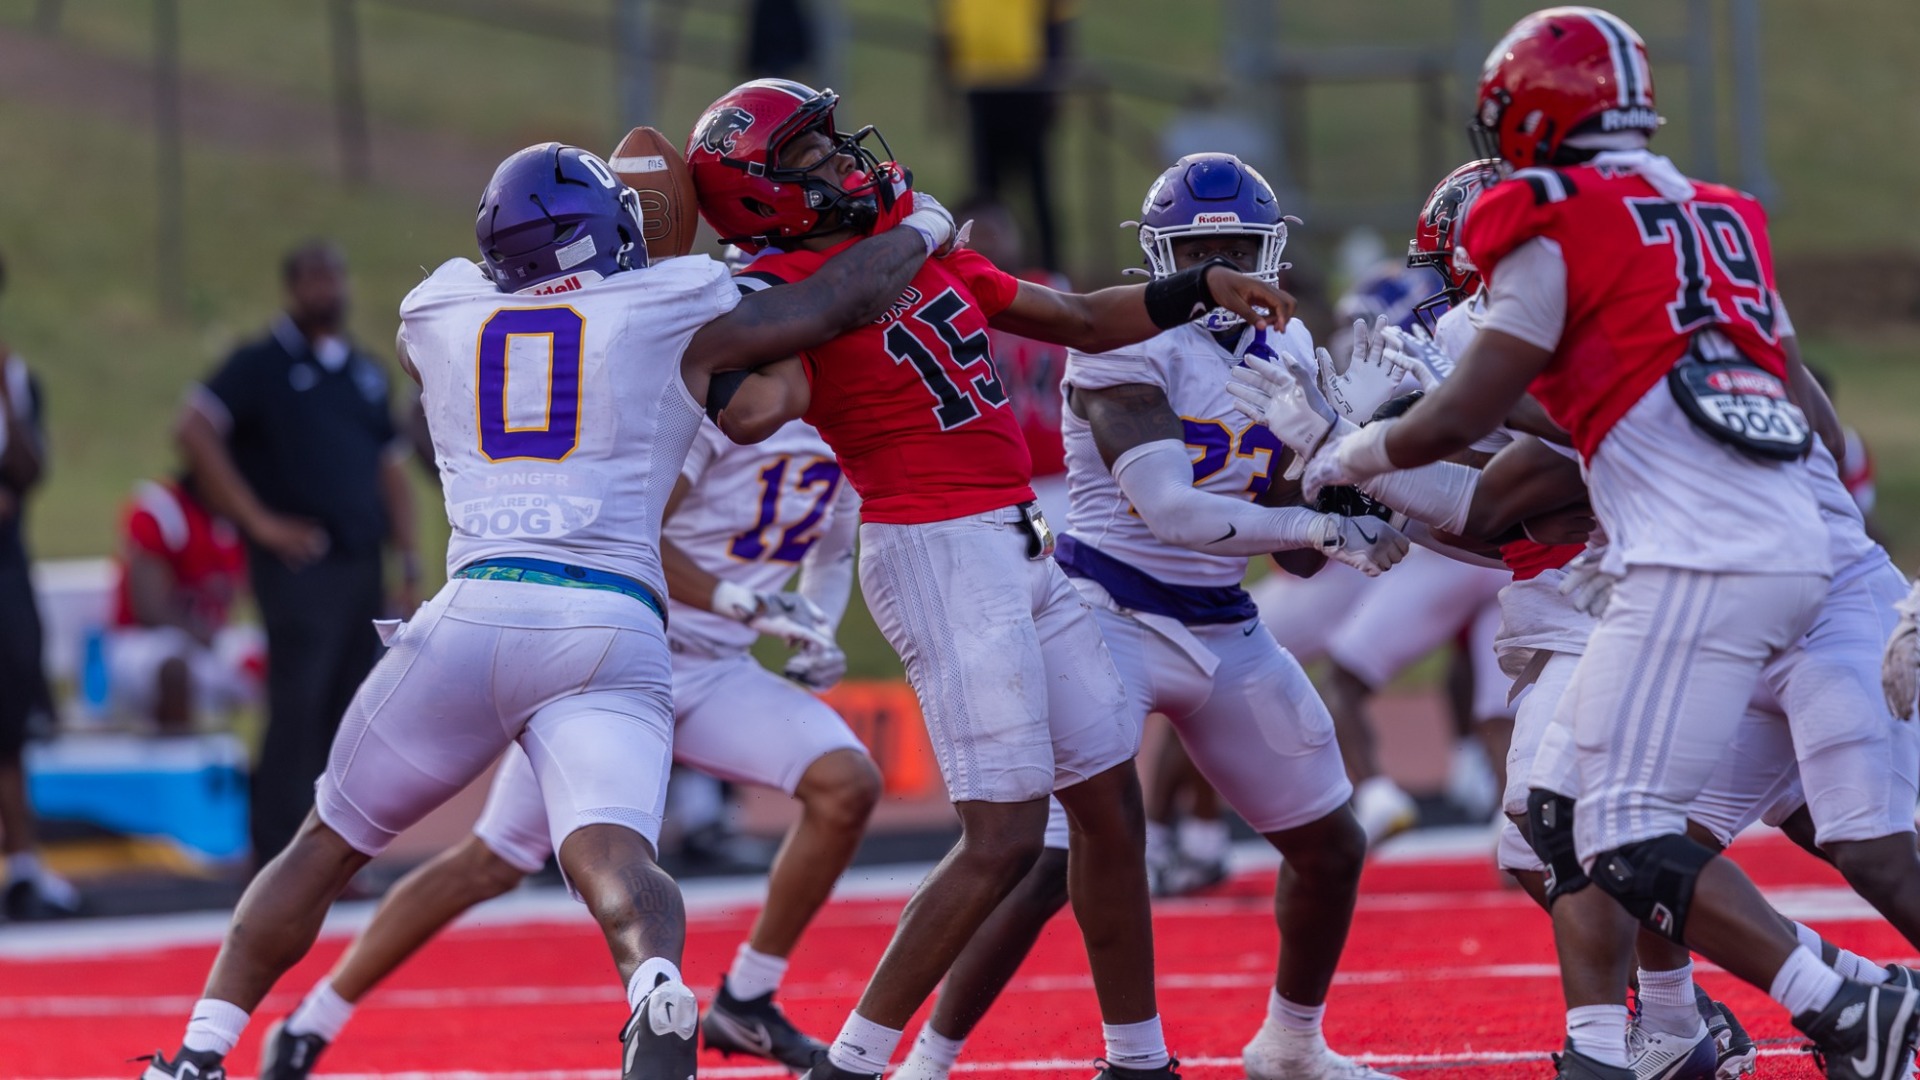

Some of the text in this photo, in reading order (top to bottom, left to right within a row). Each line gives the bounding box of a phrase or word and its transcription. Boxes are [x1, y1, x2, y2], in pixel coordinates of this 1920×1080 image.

[578, 154, 616, 189] 0
[1622, 196, 1778, 345] 79
[475, 304, 587, 464] 0
[883, 286, 1009, 431] 15
[1179, 415, 1283, 506] 23
[1722, 411, 1791, 436] DOG
[463, 508, 552, 536] DOG
[486, 472, 569, 489] DANGER
[726, 454, 842, 566] 12
